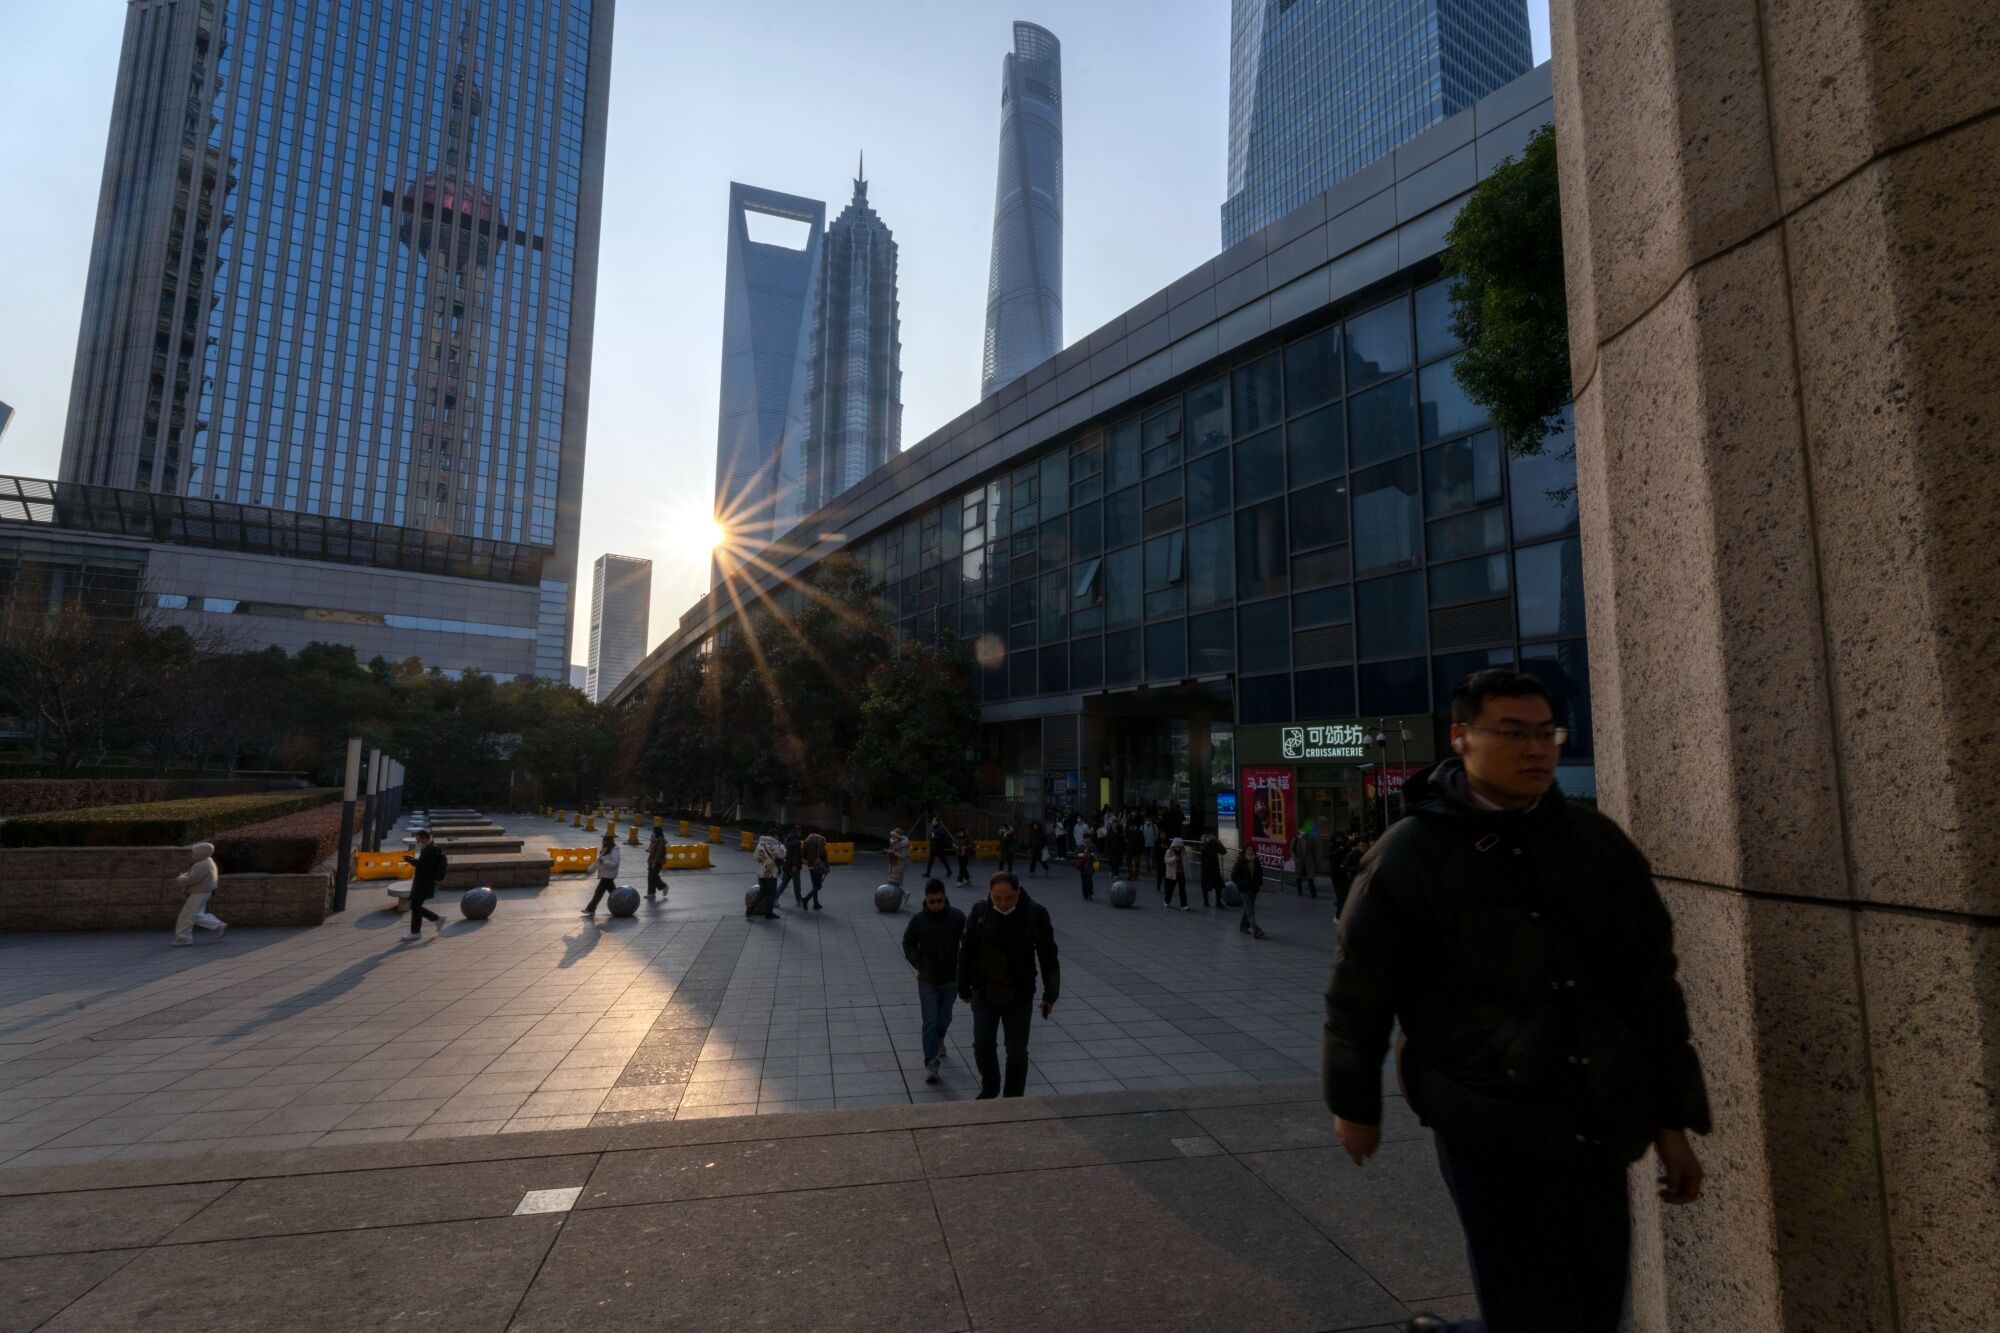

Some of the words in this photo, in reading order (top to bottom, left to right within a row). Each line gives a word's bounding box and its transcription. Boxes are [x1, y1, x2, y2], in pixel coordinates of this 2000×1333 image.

[1306, 724, 1363, 746] 可颂坊
[1305, 747, 1364, 758] CROISSANTERIE
[1258, 843, 1283, 855] Hello
